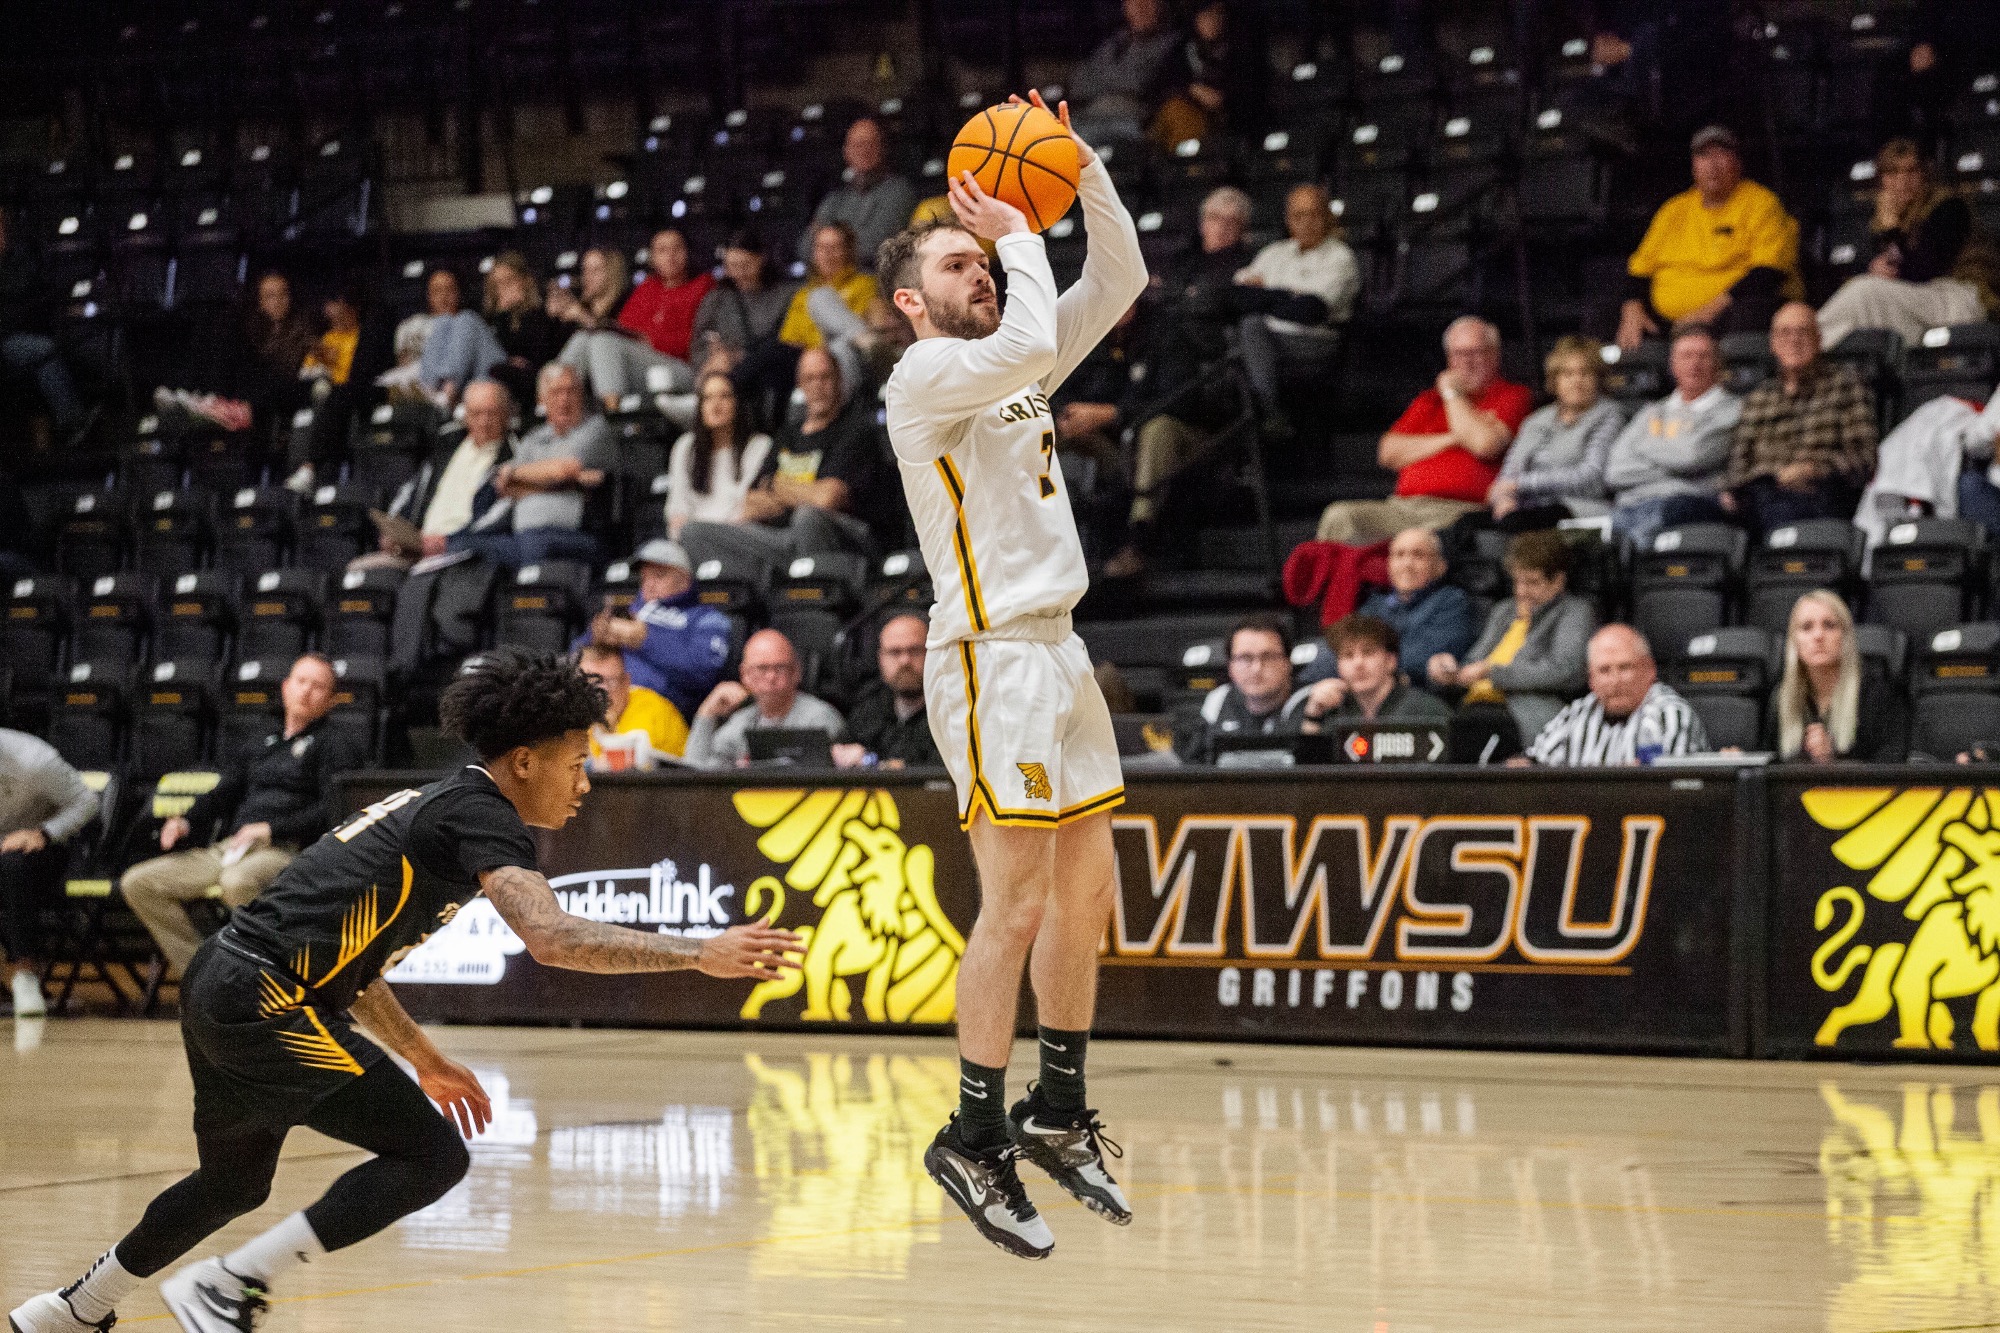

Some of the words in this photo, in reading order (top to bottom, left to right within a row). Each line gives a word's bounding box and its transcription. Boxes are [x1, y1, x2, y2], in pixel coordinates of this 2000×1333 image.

[555, 858, 734, 925] uddenlink
[1099, 815, 1666, 964] MWSU
[1217, 967, 1475, 1012] GRIFFONS
